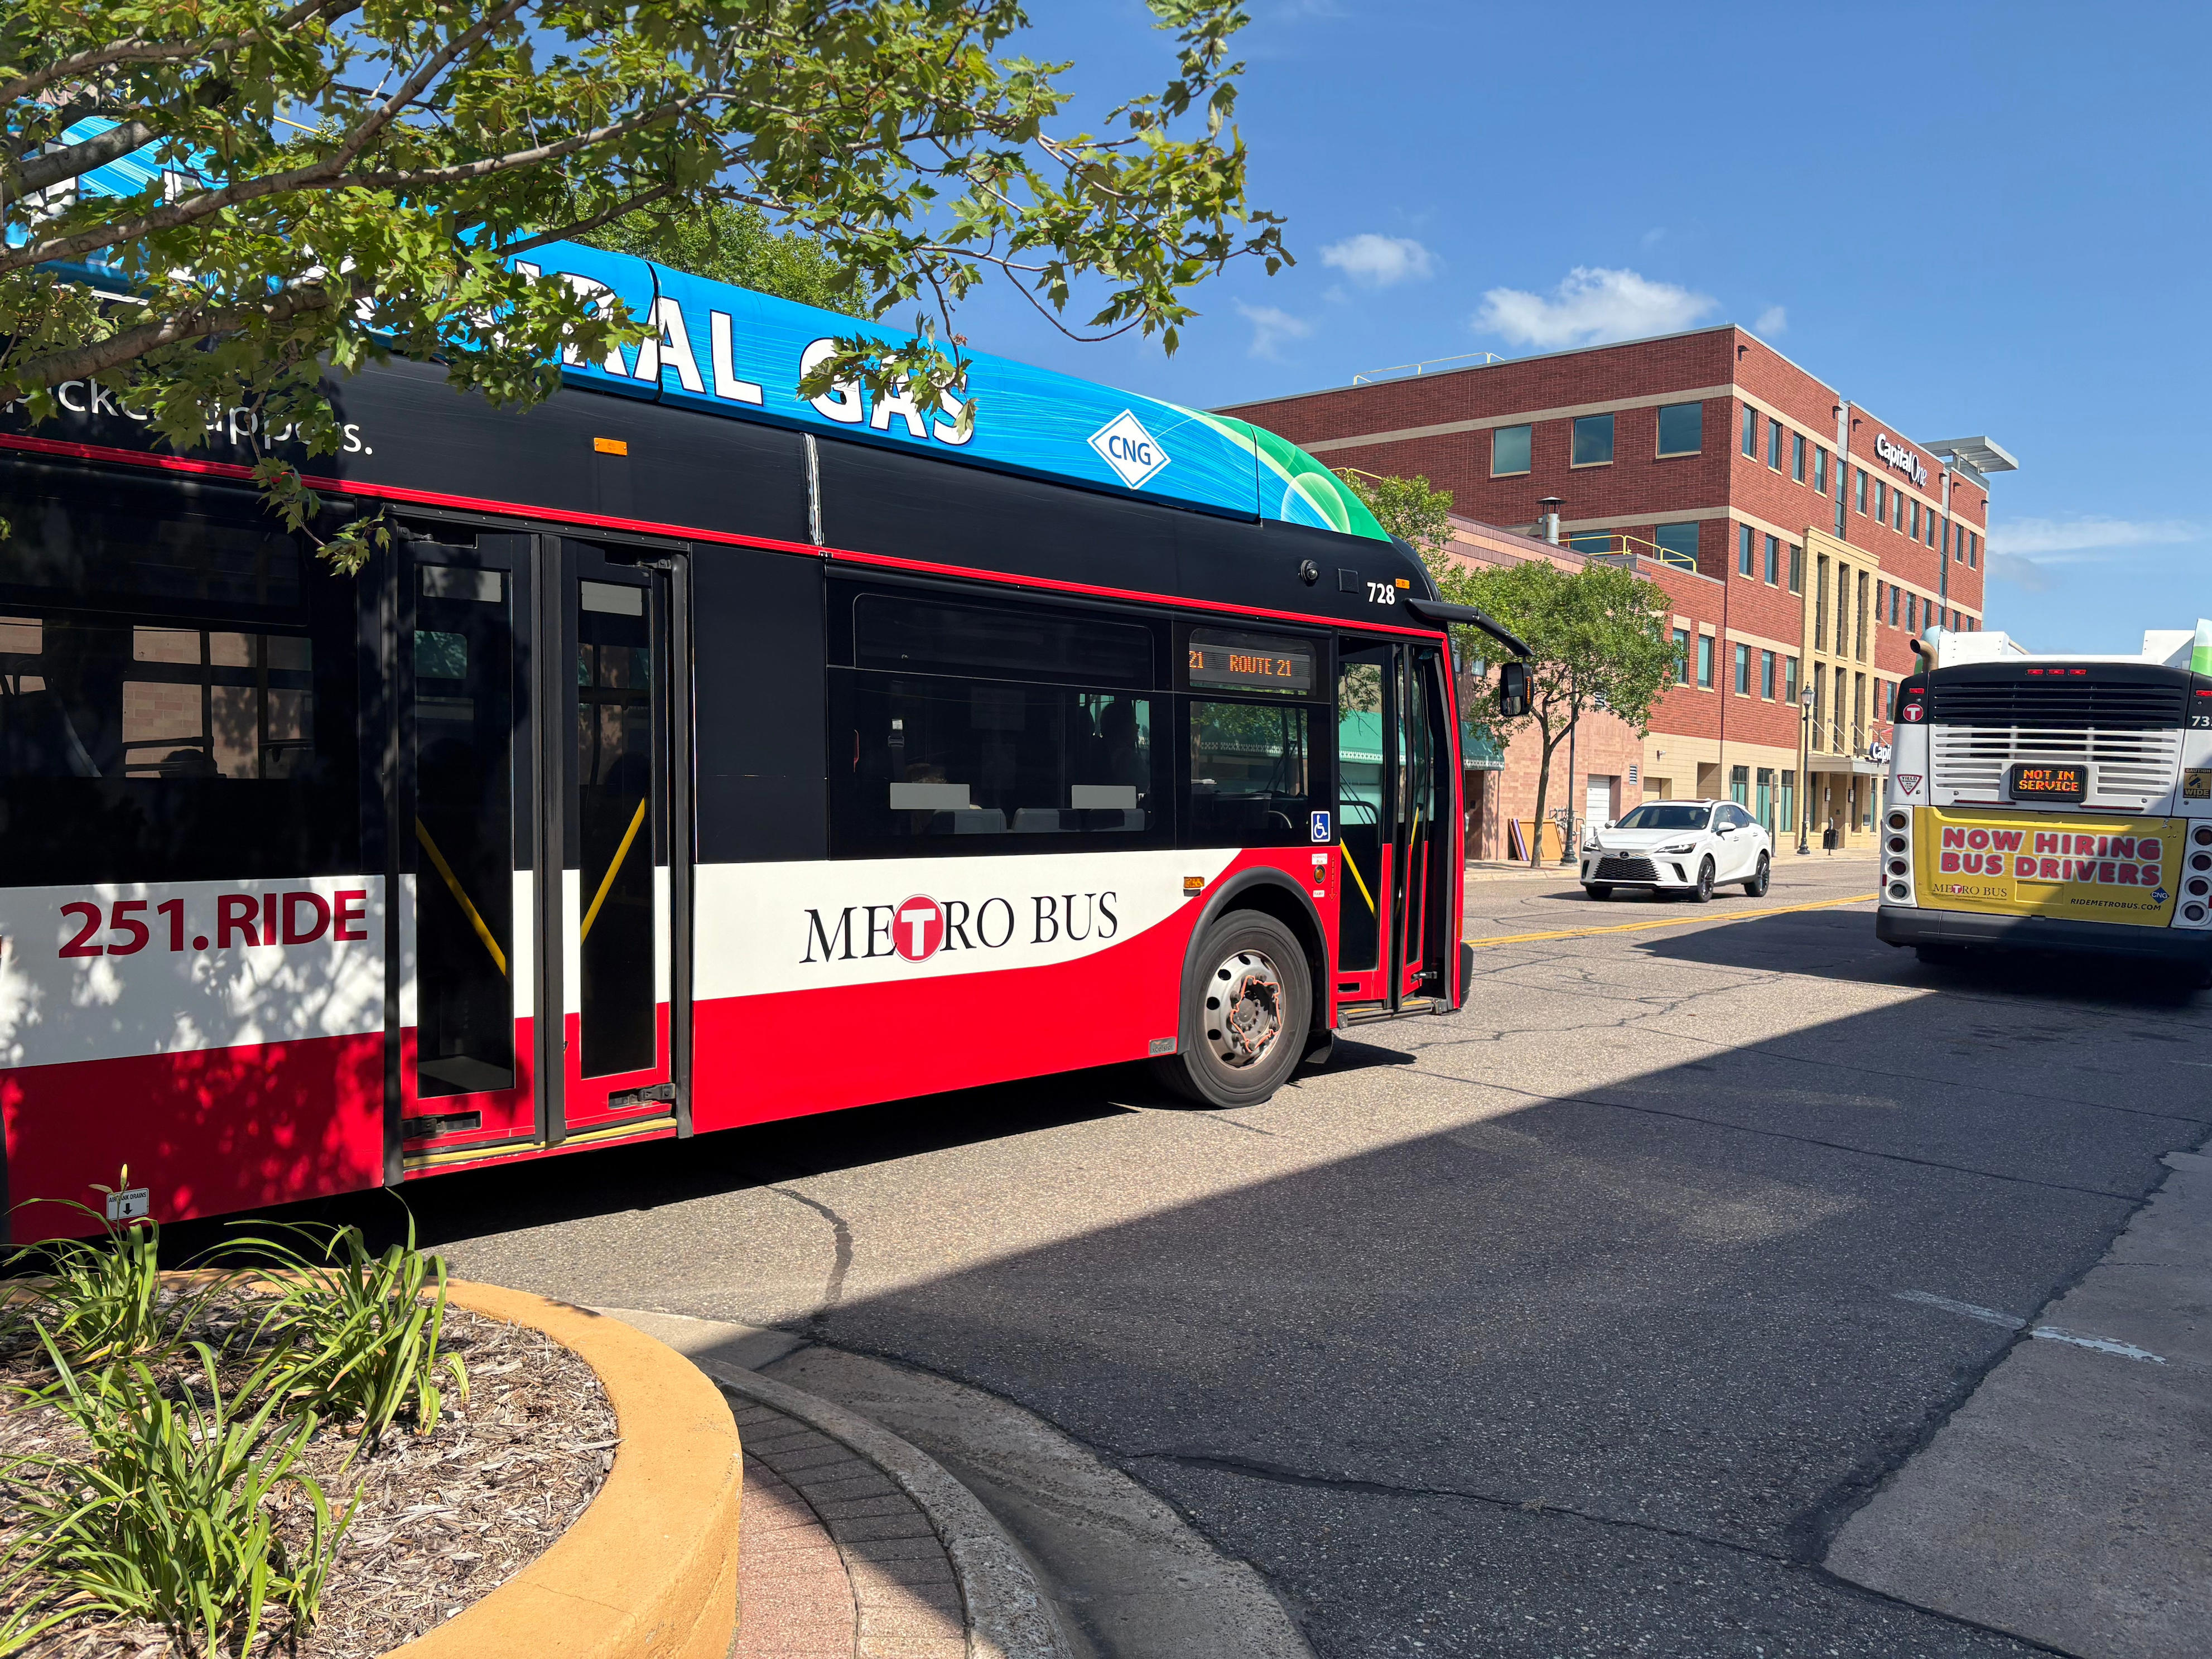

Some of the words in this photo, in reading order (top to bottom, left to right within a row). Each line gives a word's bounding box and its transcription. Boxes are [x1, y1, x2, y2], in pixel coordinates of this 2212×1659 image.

[799, 336, 975, 446] GAS
[1109, 435, 1151, 466] CNG
[1367, 582, 1395, 605] 728
[1189, 650, 1204, 669] 21
[1230, 654, 1273, 675] ROUTE
[1276, 659, 1291, 677] 21
[2192, 716, 2212, 727] 73
[2019, 780, 2079, 792] SERVICE
[2023, 770, 2052, 780] NOT
[2057, 771, 2074, 780] IN
[1942, 827, 2025, 852] NOW
[2034, 831, 2162, 861] HIRING
[1940, 850, 2004, 876] BUS
[2014, 855, 2162, 887] DRIVERS
[1933, 884, 1980, 895] METRO
[1984, 887, 2007, 897] BUS
[2071, 899, 2161, 911] RIDEMETROBUS.COM
[59, 890, 368, 958] 251.RIDE
[799, 894, 1014, 963] METRO
[1030, 891, 1117, 944] BUS
